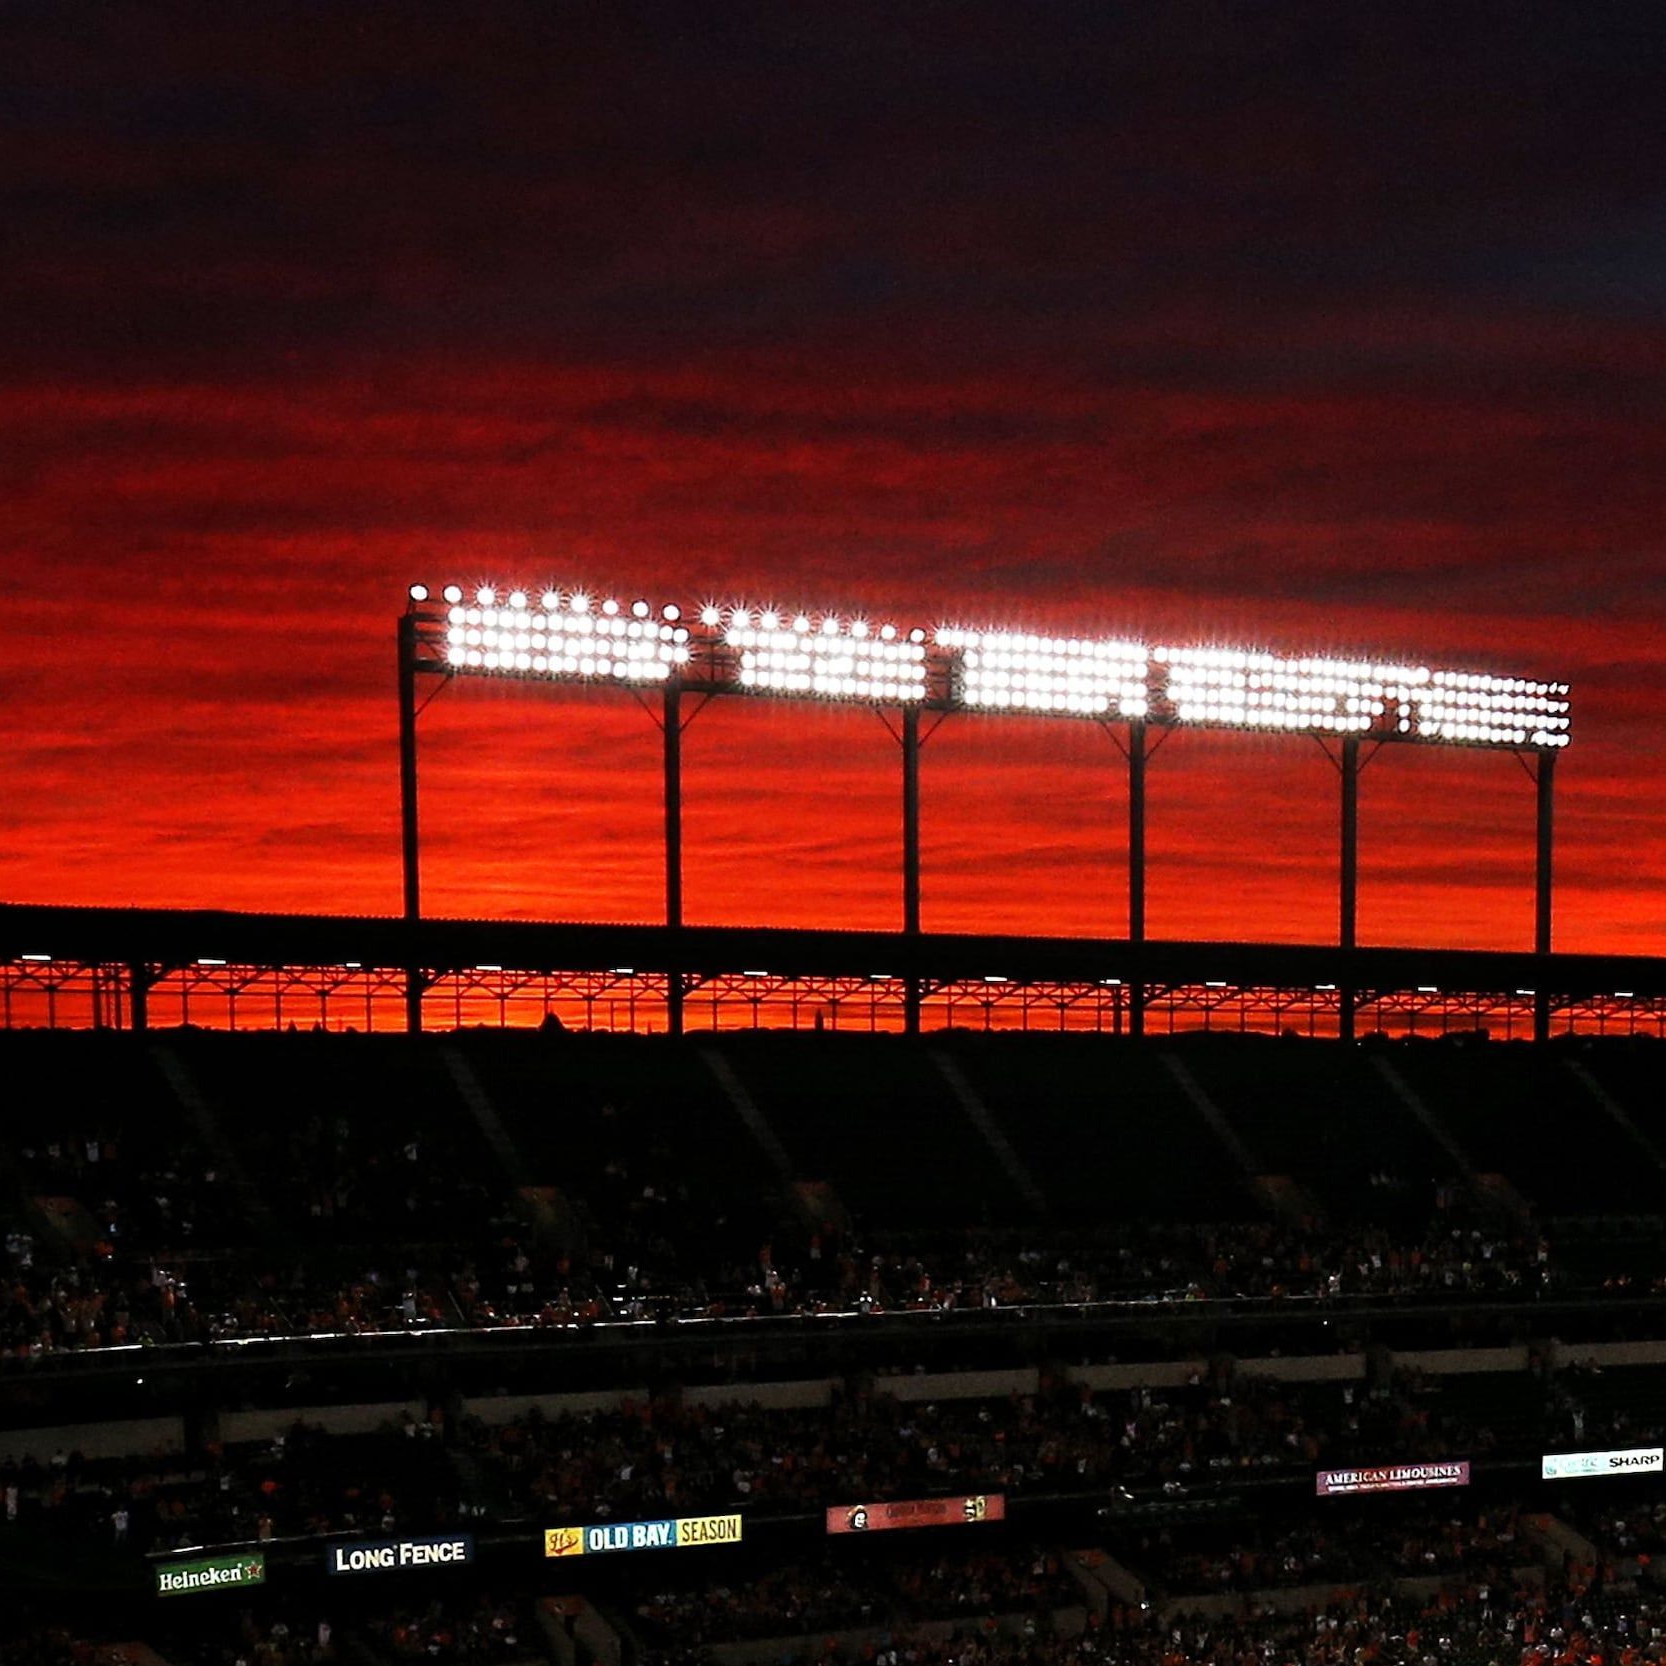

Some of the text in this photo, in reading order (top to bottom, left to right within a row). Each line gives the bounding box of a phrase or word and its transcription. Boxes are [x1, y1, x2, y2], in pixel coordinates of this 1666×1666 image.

[1325, 1471, 1387, 1485] AMERICAN
[1389, 1465, 1461, 1480] LIMOUSINES
[1609, 1454, 1660, 1468] SHARP
[589, 1527, 628, 1550] OLD
[681, 1518, 737, 1542] SEASON
[336, 1541, 466, 1572] LONG FENCE
[159, 1564, 242, 1592] Heineken
